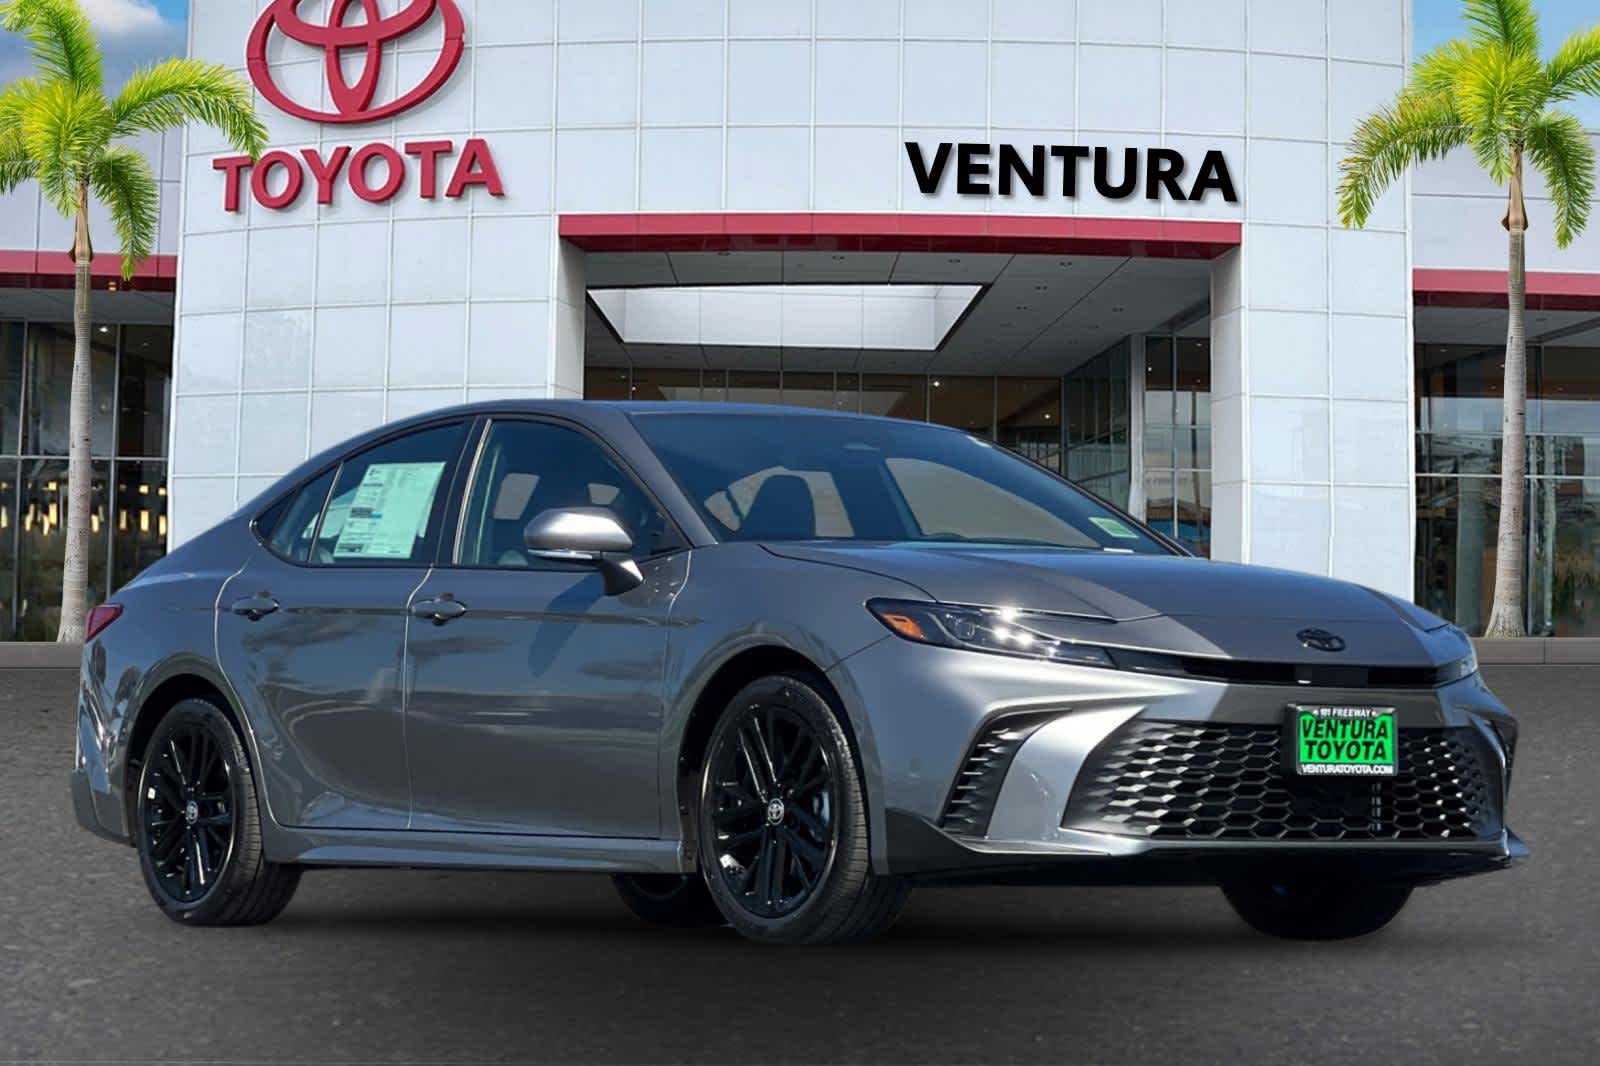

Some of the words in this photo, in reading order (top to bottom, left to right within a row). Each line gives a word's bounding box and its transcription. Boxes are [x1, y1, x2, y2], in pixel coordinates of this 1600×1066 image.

[212, 138, 505, 212] TOYOTA
[904, 142, 1238, 203] VENTURA
[1332, 708, 1372, 717] FREEWAY
[1302, 719, 1388, 739] VENTURA
[1304, 740, 1386, 760] TOYOTA
